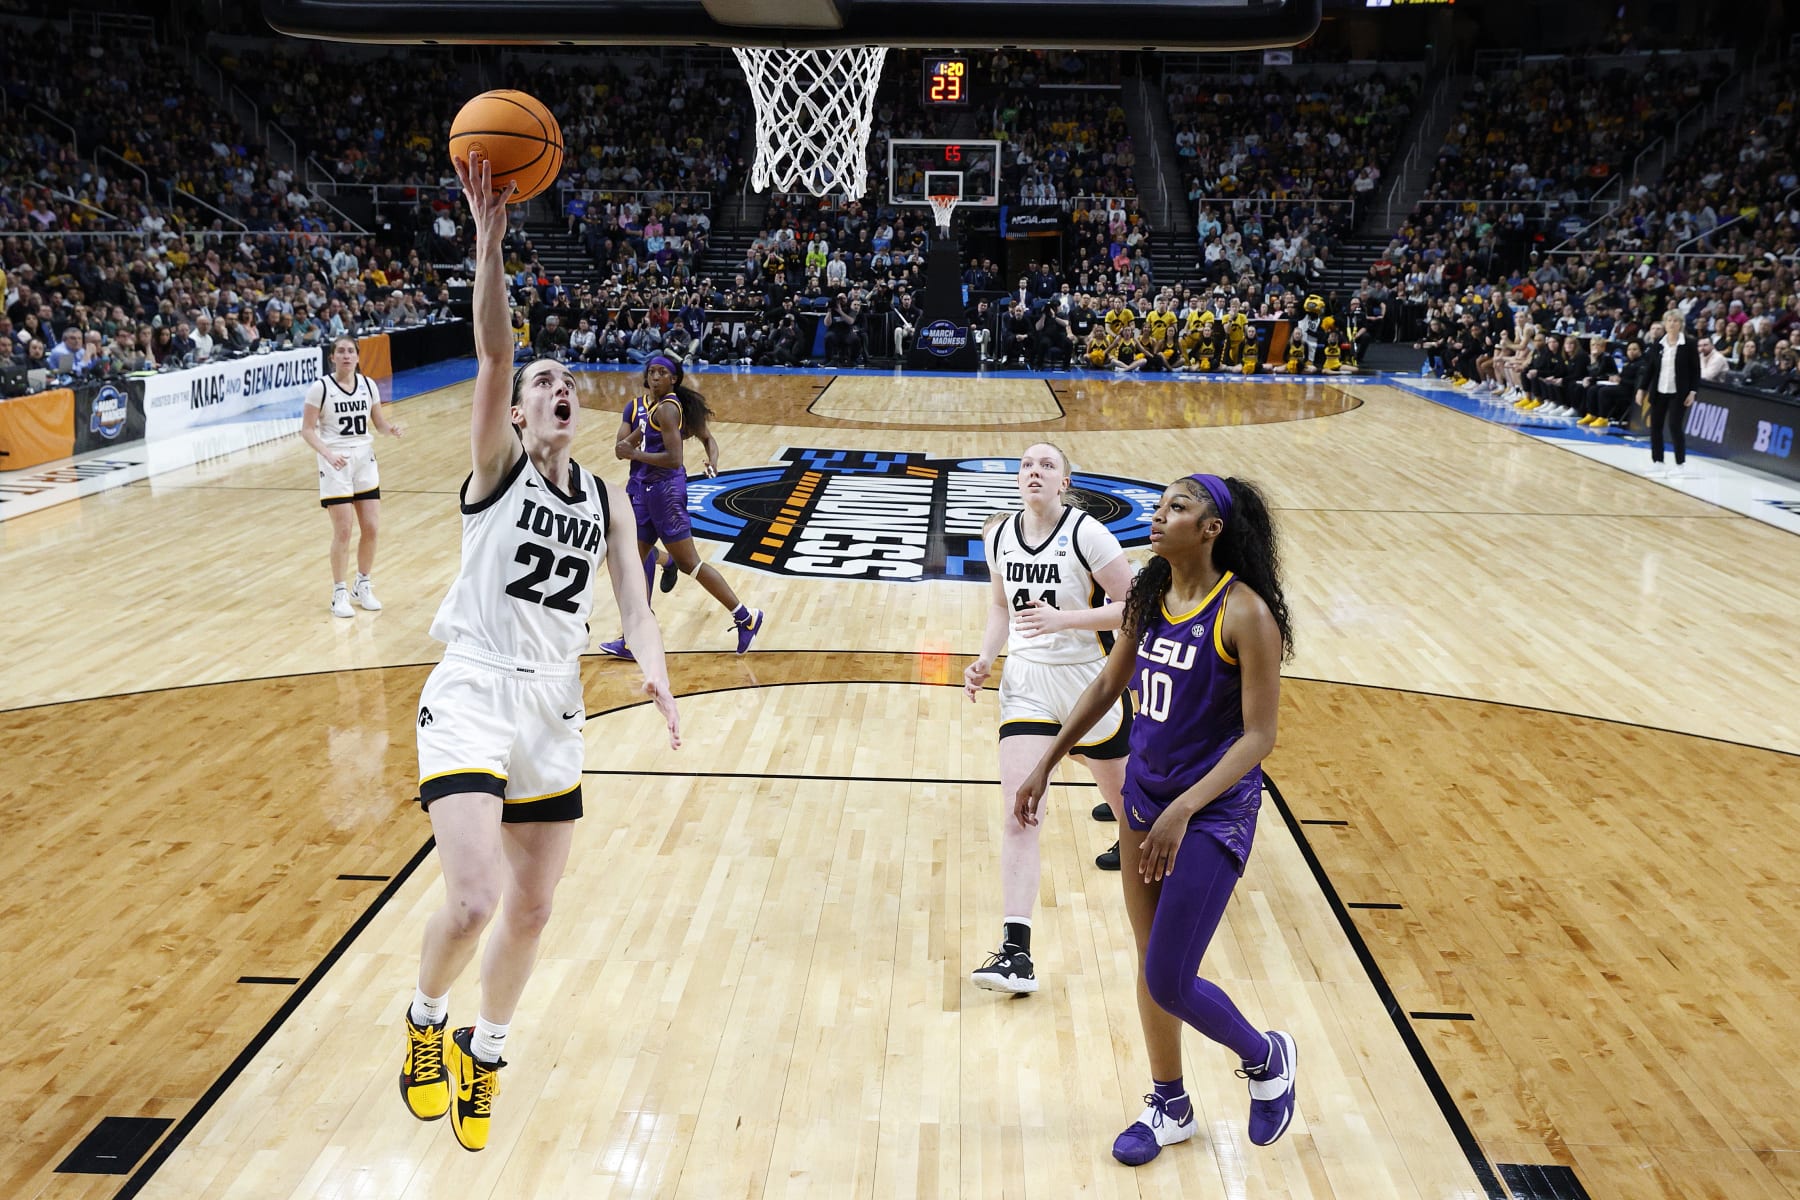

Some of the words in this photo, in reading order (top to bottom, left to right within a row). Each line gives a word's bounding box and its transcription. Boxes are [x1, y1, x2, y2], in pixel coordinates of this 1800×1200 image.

[940, 63, 964, 76] 1:20
[931, 77, 960, 100] 23
[1011, 215, 1058, 225] NCAA.com
[929, 330, 954, 338] MARCH
[932, 337, 966, 345] MADNESS
[226, 378, 241, 394] AND
[243, 364, 273, 397] SIENA
[274, 357, 318, 389] COLLEGE
[334, 400, 368, 413] IOWA
[339, 415, 367, 436] 20
[1685, 401, 1729, 444] IOWA
[516, 499, 602, 555] IOWA
[784, 475, 934, 578] MADNESS
[505, 542, 590, 614] 22
[1006, 562, 1062, 584] IOWA
[1012, 588, 1060, 612] 44
[1137, 632, 1198, 671] LSU
[1140, 667, 1173, 723] 10
